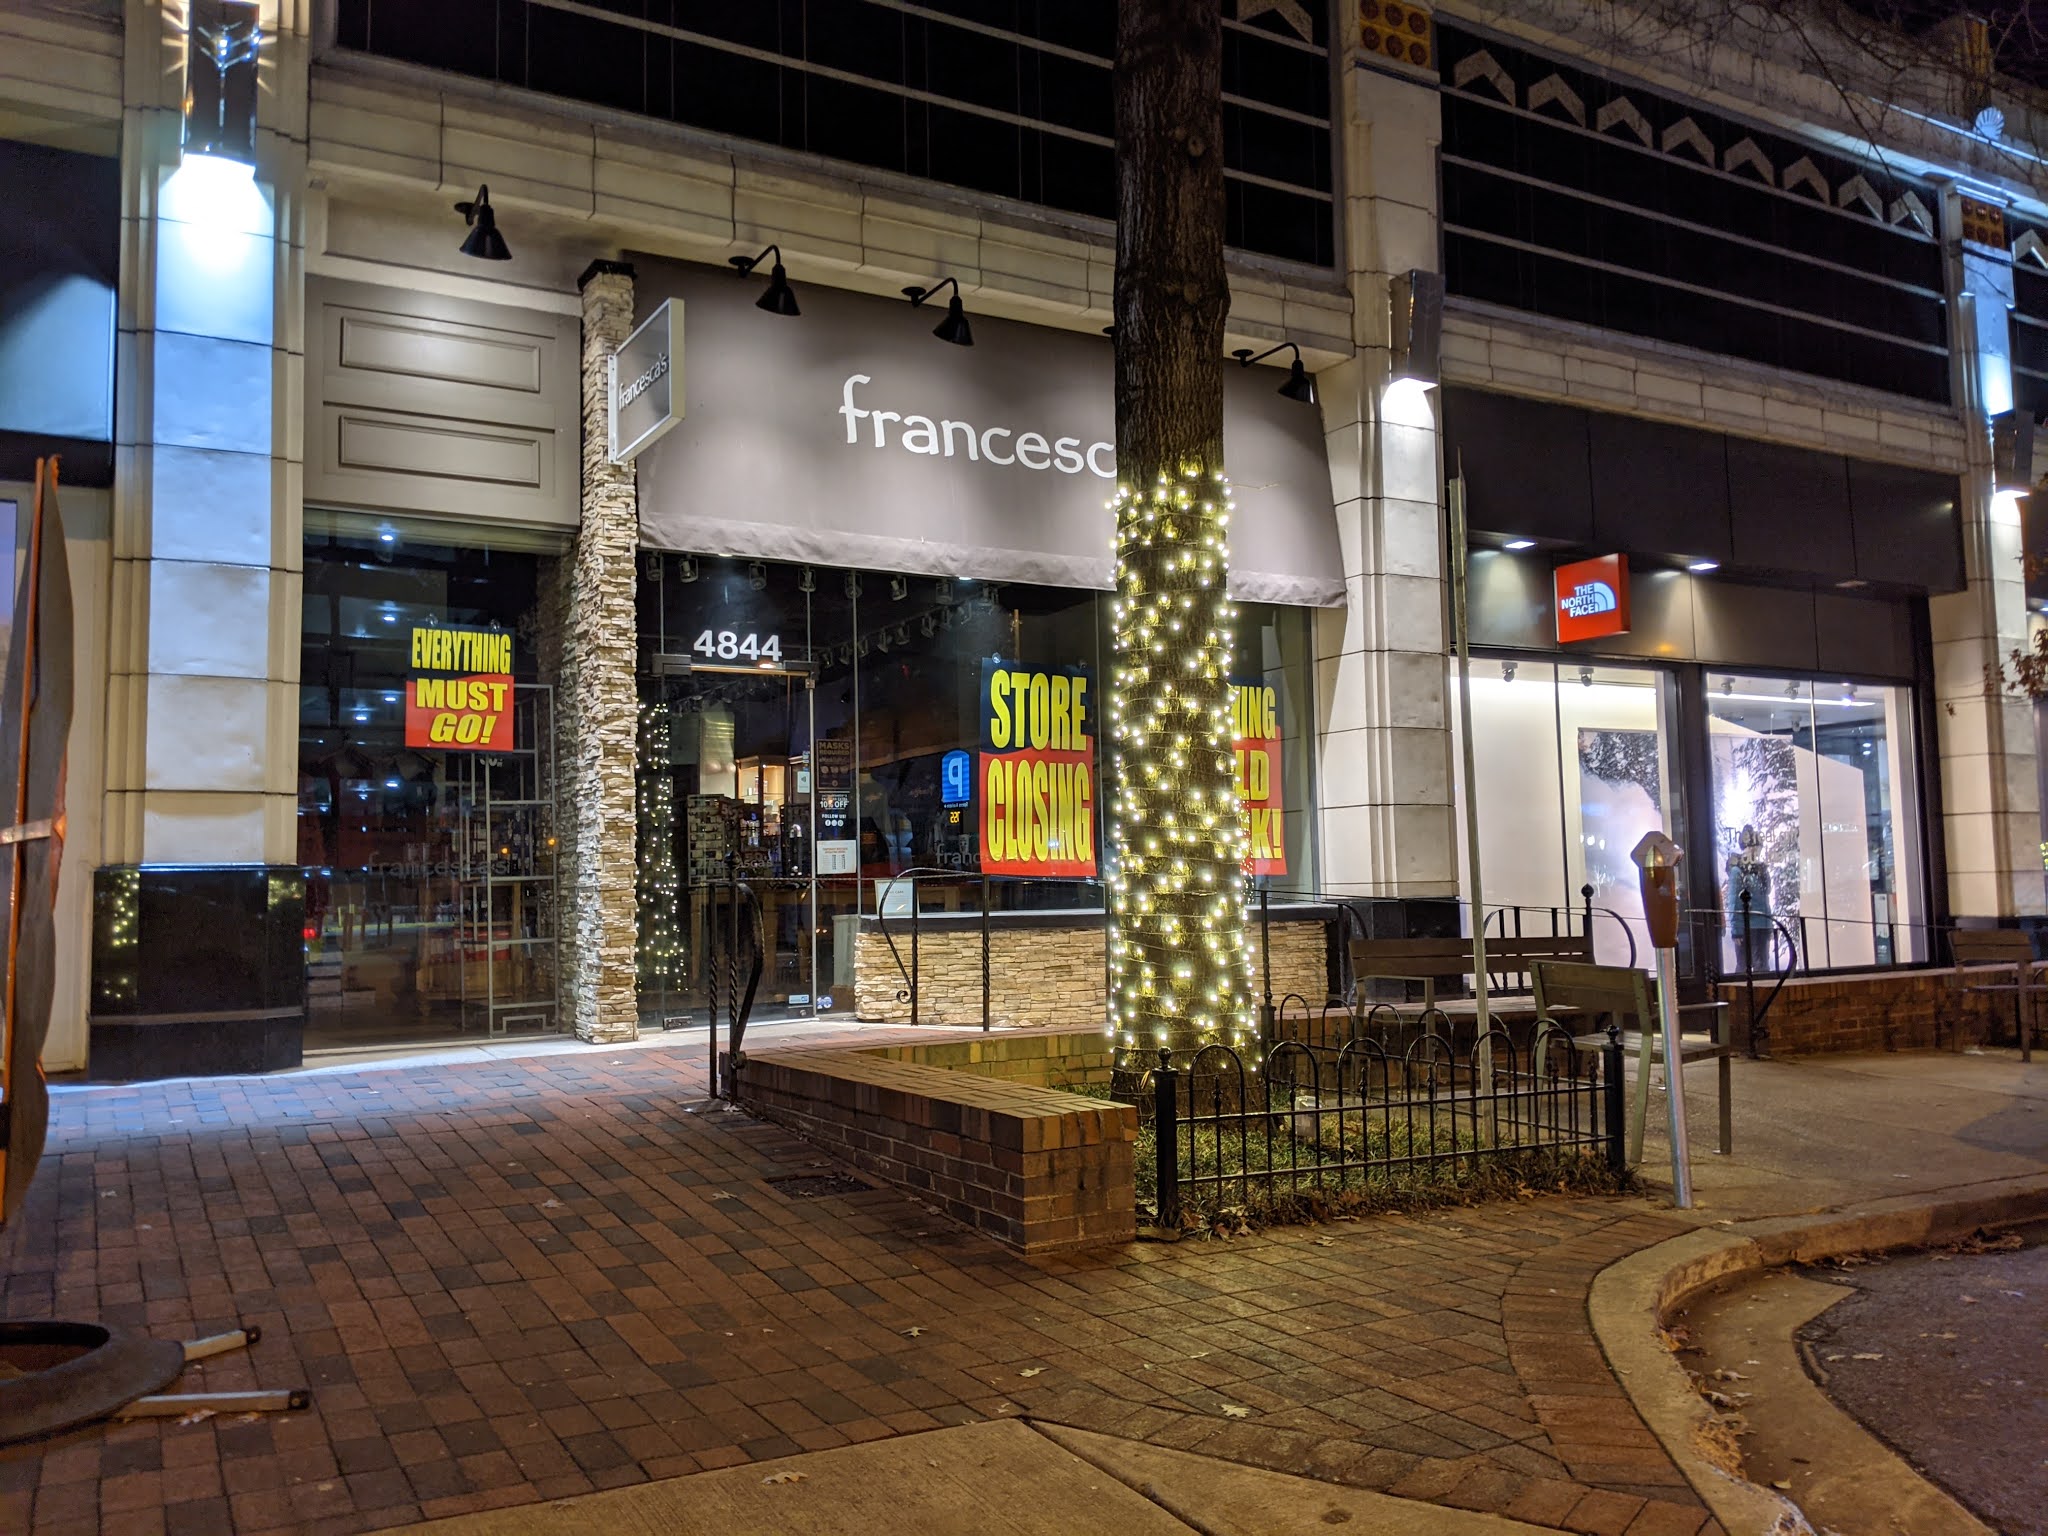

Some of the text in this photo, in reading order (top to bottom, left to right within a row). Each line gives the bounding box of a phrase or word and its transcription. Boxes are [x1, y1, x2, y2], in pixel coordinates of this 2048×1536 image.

[618, 353, 668, 411] francesca's
[1561, 594, 1595, 610] NORTH
[1574, 583, 1594, 597] THE
[1569, 603, 1595, 618] FACE
[411, 627, 511, 675] EVERYTHING
[693, 629, 783, 662] 4844
[416, 678, 508, 712] MUST
[990, 669, 1087, 751] STORE
[429, 712, 497, 744] GO!
[819, 741, 850, 750] MASKS
[987, 758, 1092, 862] CLOSING
